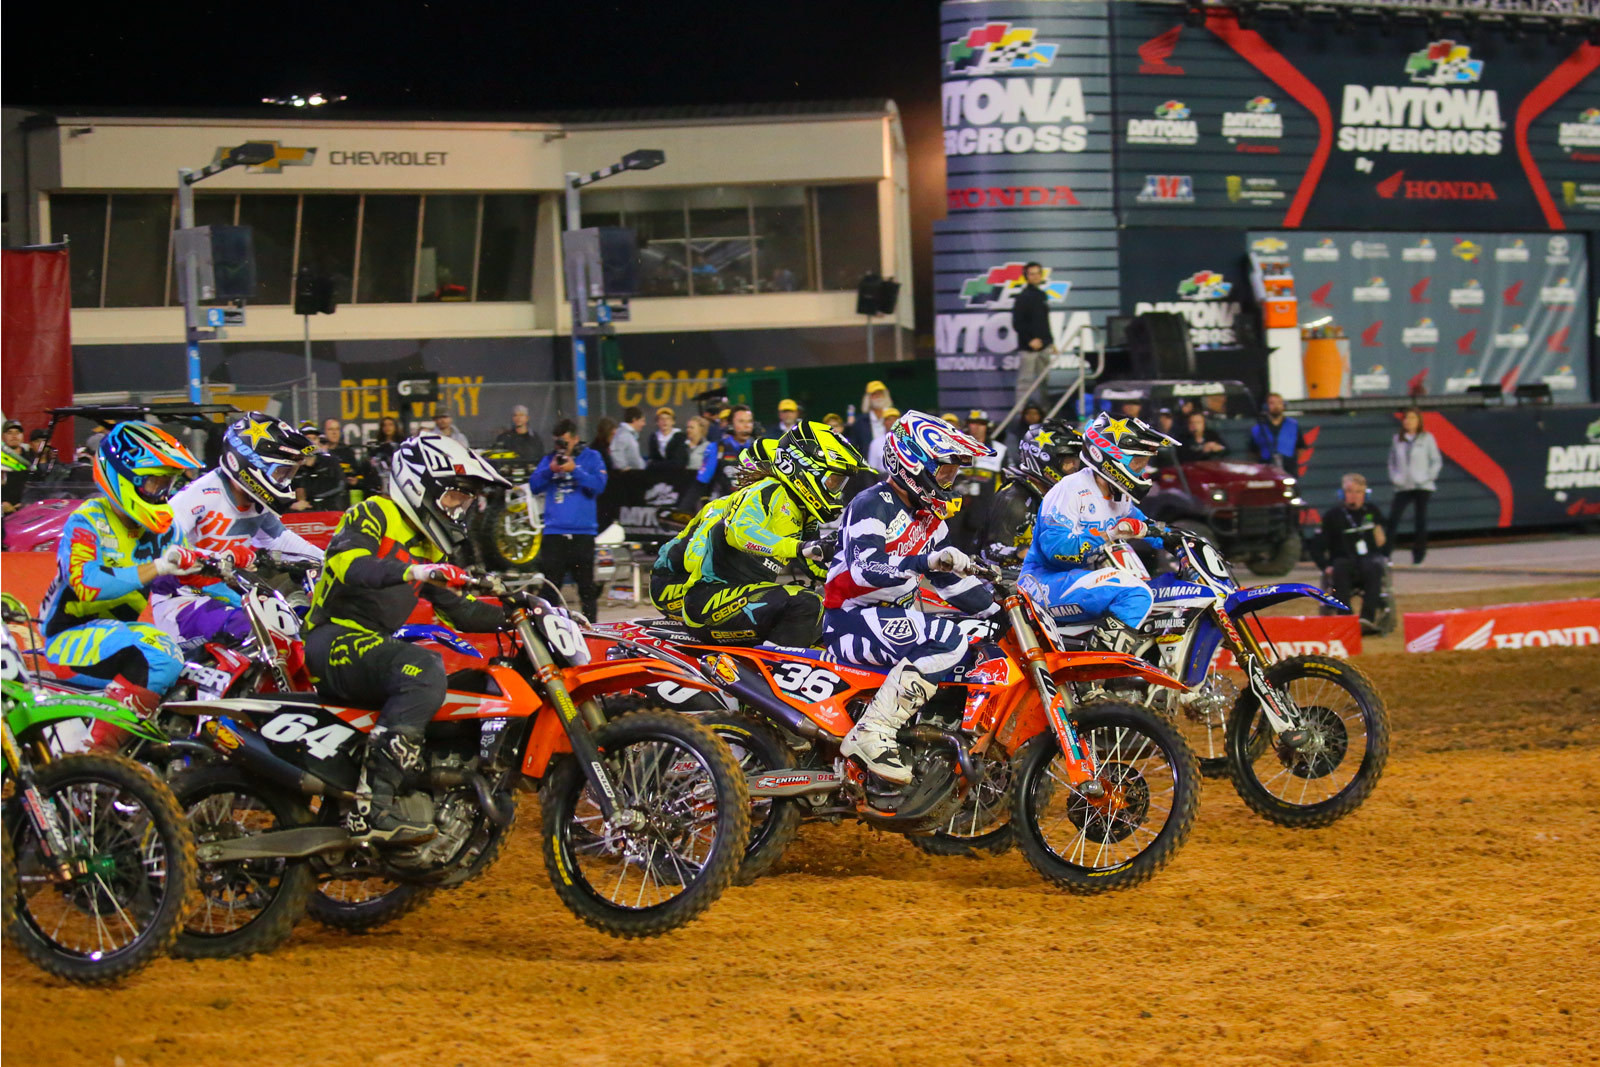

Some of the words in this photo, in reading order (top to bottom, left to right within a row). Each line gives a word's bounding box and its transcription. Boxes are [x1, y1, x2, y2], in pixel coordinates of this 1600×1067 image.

[1341, 85, 1500, 129] DAYTONA
[1338, 127, 1502, 155] SUPERCROSS
[329, 150, 448, 167] CHEVROLET
[948, 186, 1081, 209] HONDA
[1404, 180, 1498, 200] HONDA
[1085, 426, 1124, 460] 100%
[1547, 445, 1600, 472] DAYT
[794, 478, 822, 509] GEICO
[744, 541, 773, 554] AMSOIL
[1157, 585, 1203, 598] YAMAHA
[711, 597, 748, 622] GEICO
[711, 630, 756, 639] GEICO
[1154, 618, 1186, 630] YAMALUBE
[1494, 626, 1600, 649] HOND
[402, 663, 423, 678] FOX
[772, 662, 841, 703] 36
[261, 713, 356, 760] 64
